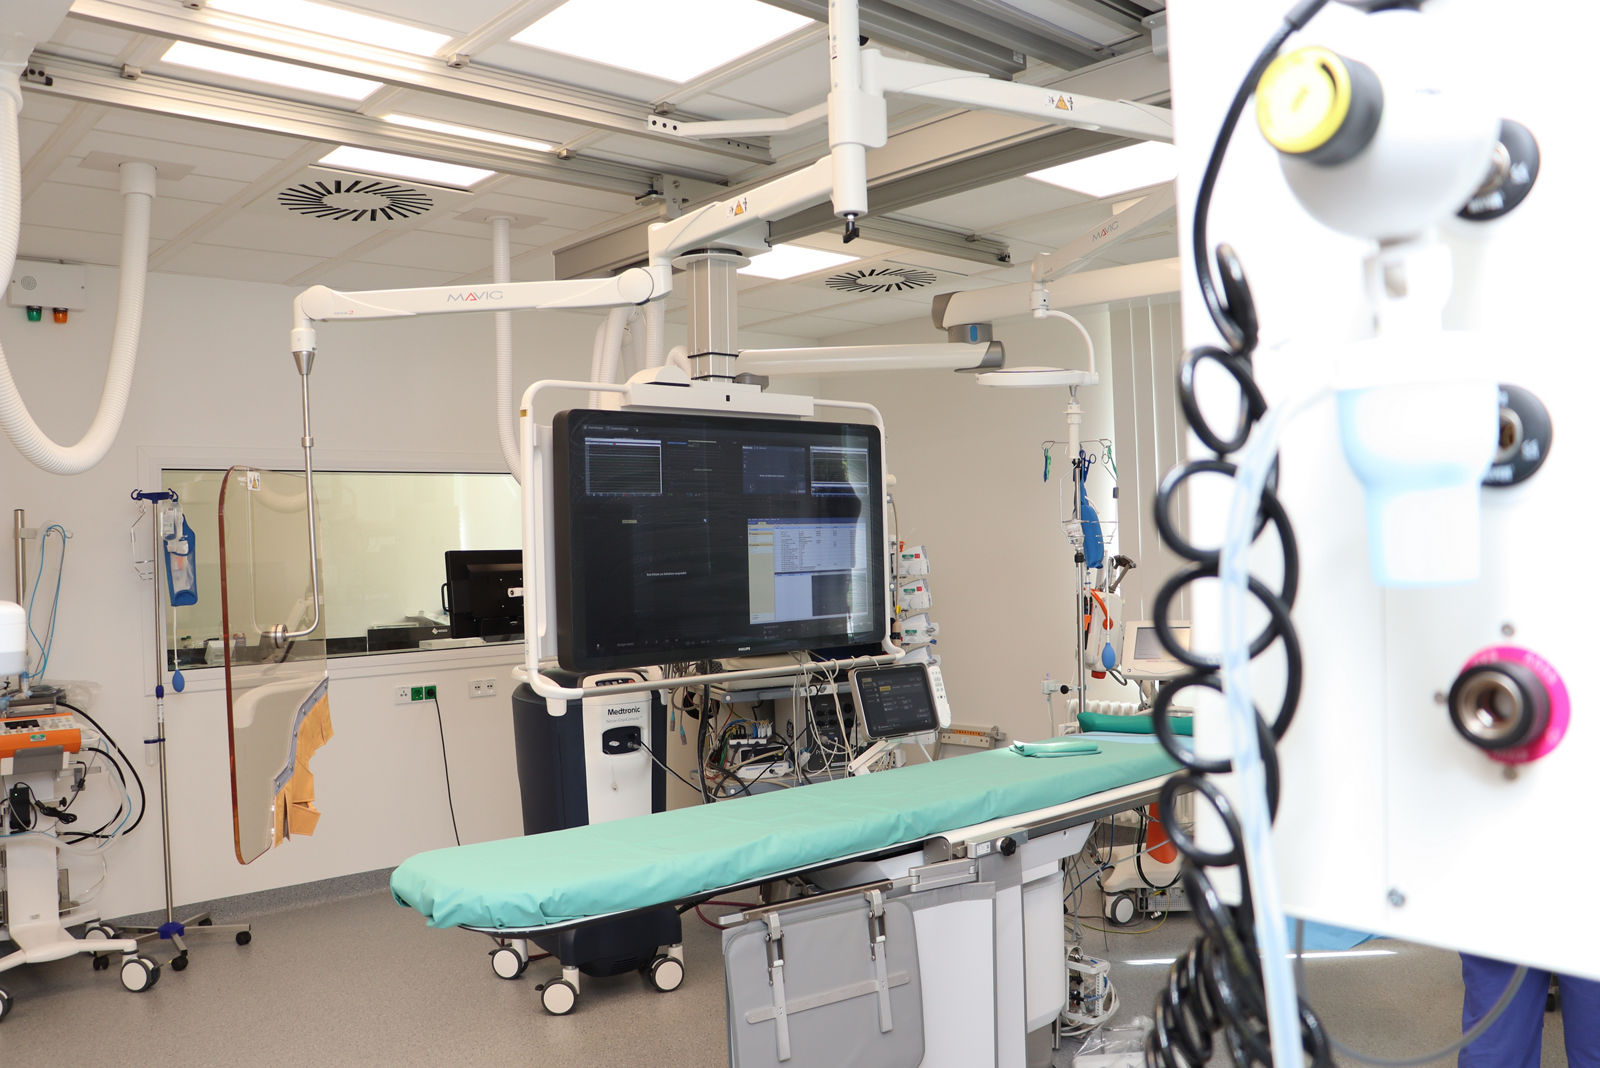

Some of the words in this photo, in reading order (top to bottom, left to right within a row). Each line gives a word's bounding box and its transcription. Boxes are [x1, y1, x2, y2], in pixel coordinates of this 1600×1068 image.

[1092, 220, 1119, 241] MAVIG
[447, 290, 504, 302] MAVIG
[607, 706, 640, 715] Medtronic
